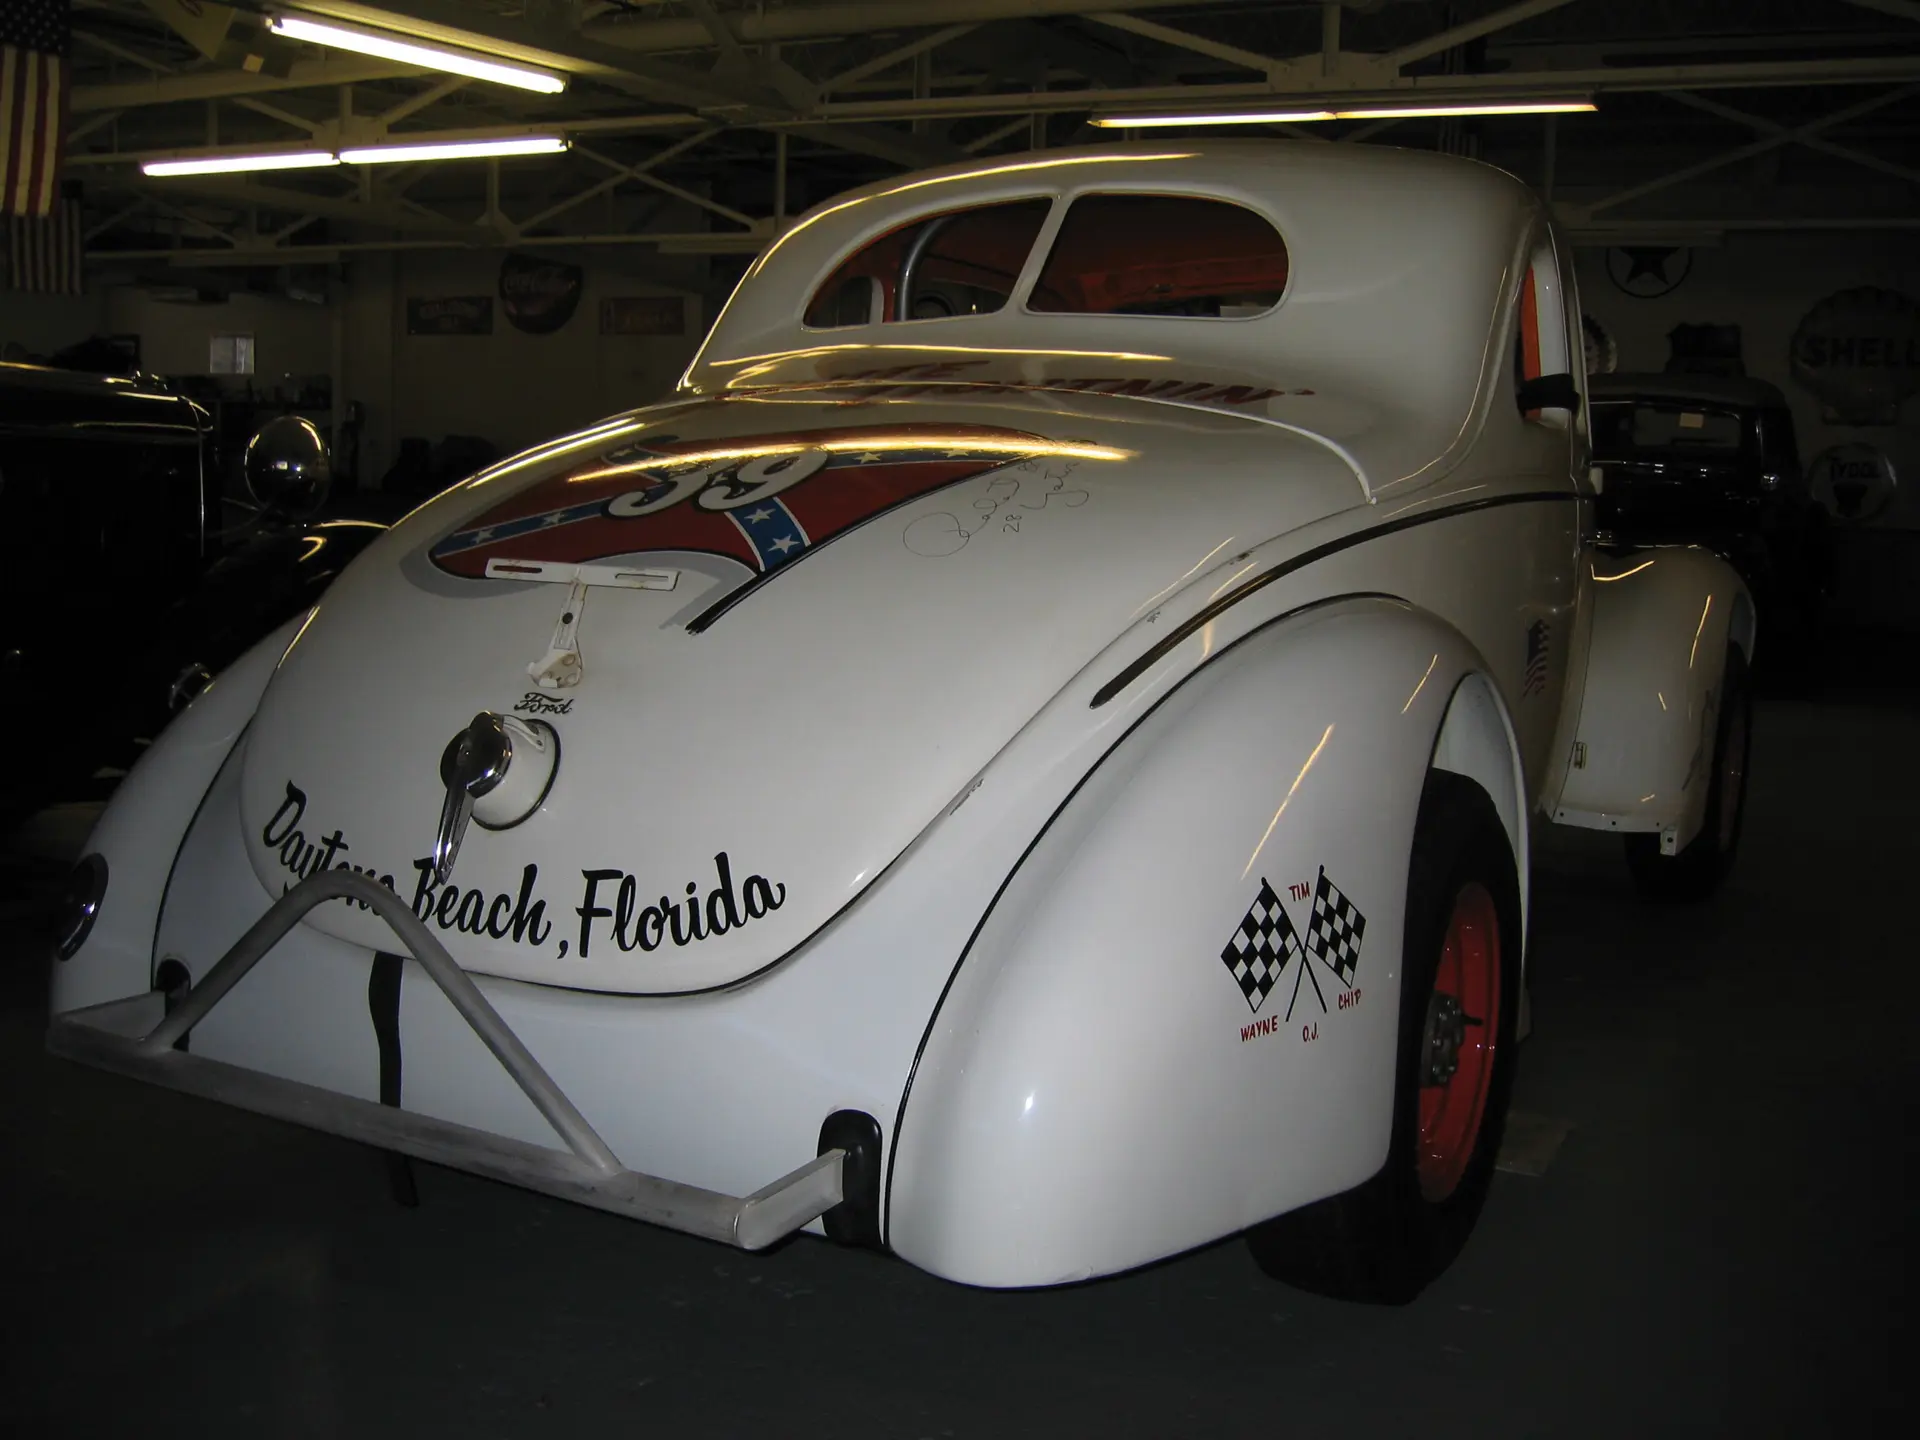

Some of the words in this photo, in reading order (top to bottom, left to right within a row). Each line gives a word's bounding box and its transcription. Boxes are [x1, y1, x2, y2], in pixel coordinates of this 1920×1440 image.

[1802, 336, 1920, 368] SHELL
[606, 449, 829, 518] 39
[1003, 513, 1023, 533] 28
[514, 692, 575, 715] Ford
[1288, 881, 1311, 902] TIM
[412, 856, 568, 960] Beach,
[574, 851, 786, 959] Florida
[1338, 988, 1362, 1010] CHIP
[1240, 1015, 1278, 1042] WAYNE
[1302, 1022, 1319, 1042] O.J.
